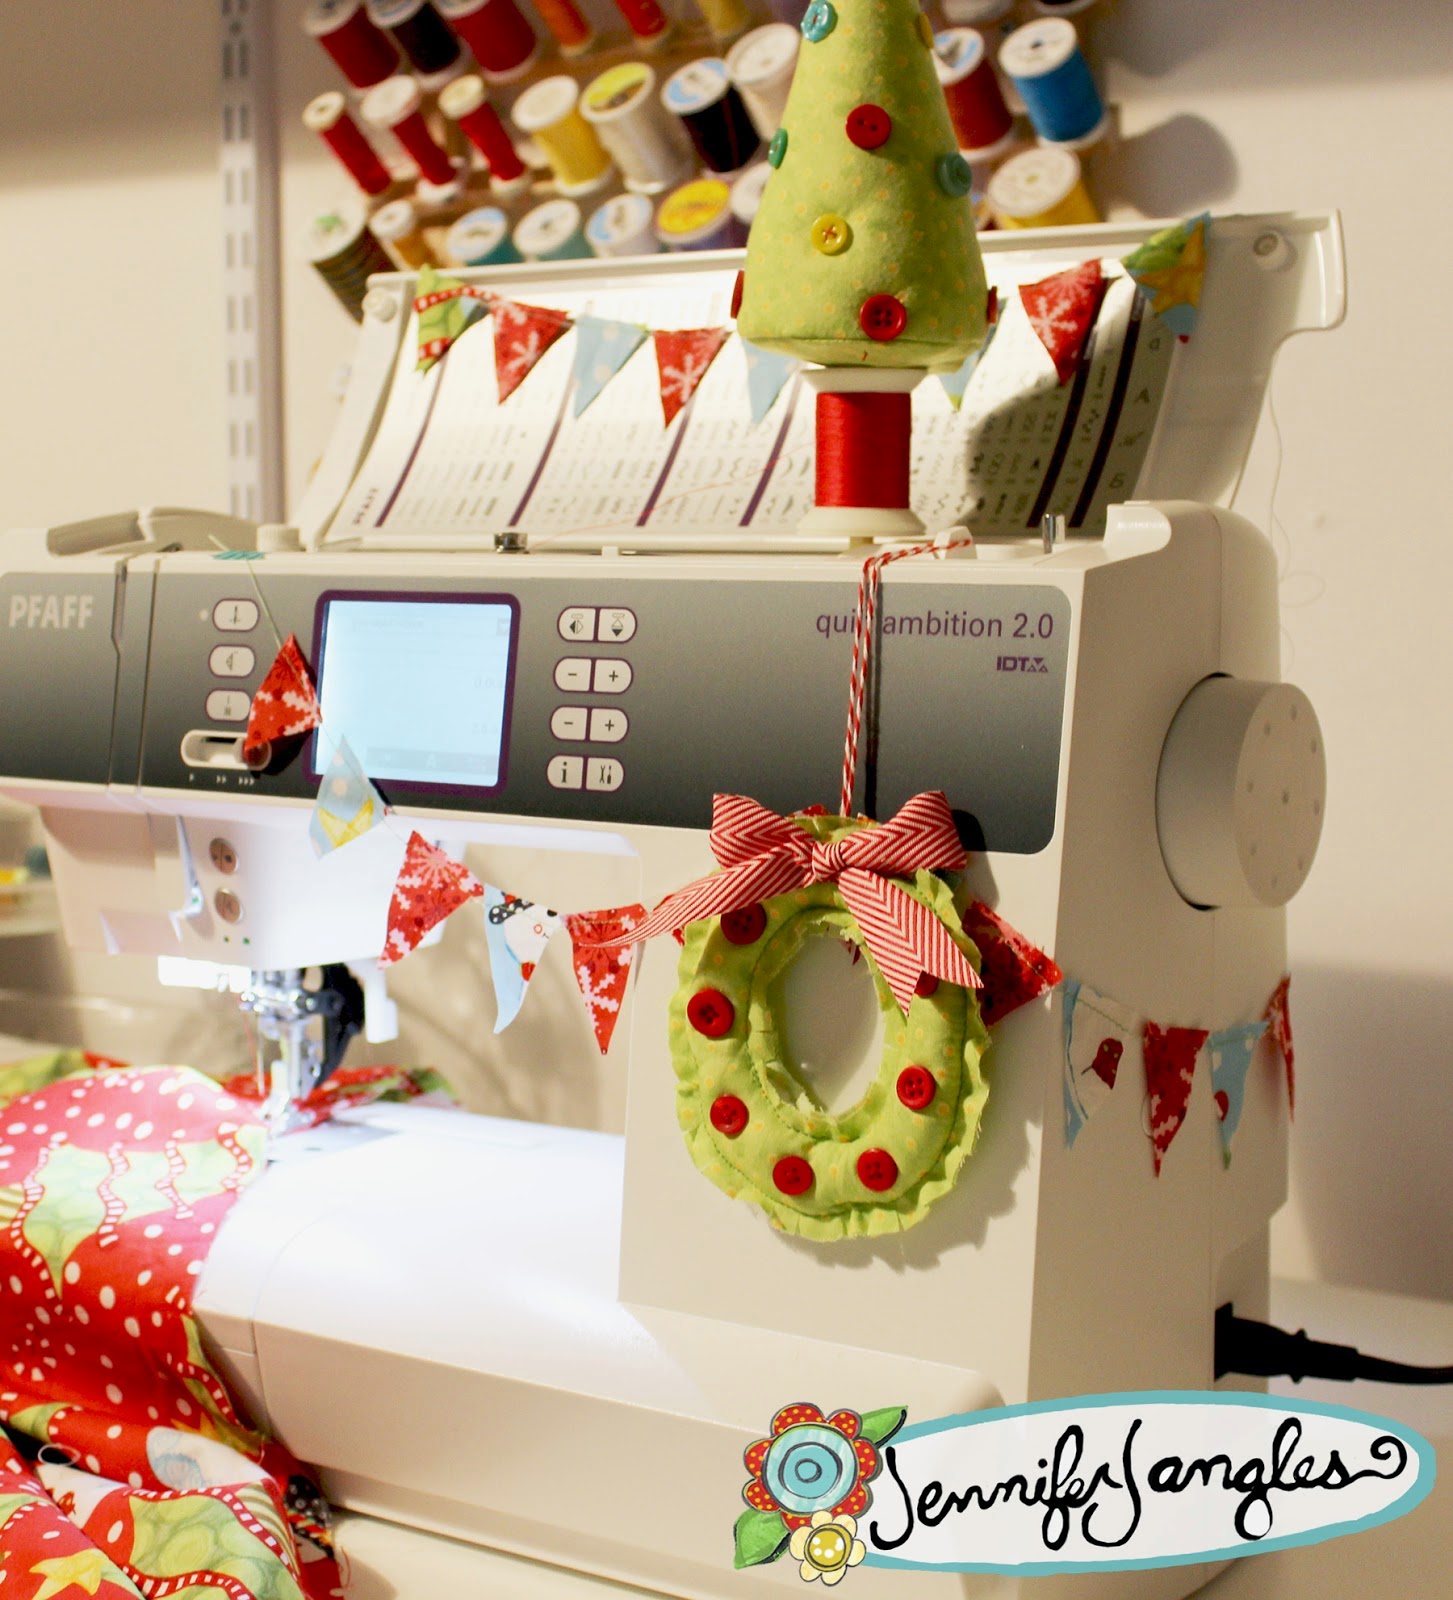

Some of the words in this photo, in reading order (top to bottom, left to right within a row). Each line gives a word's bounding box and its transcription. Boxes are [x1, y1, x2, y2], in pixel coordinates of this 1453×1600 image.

[8, 595, 94, 629] PFAFF
[816, 608, 870, 639] qui
[882, 610, 1003, 637] ambition
[1012, 612, 1055, 638] 2.0
